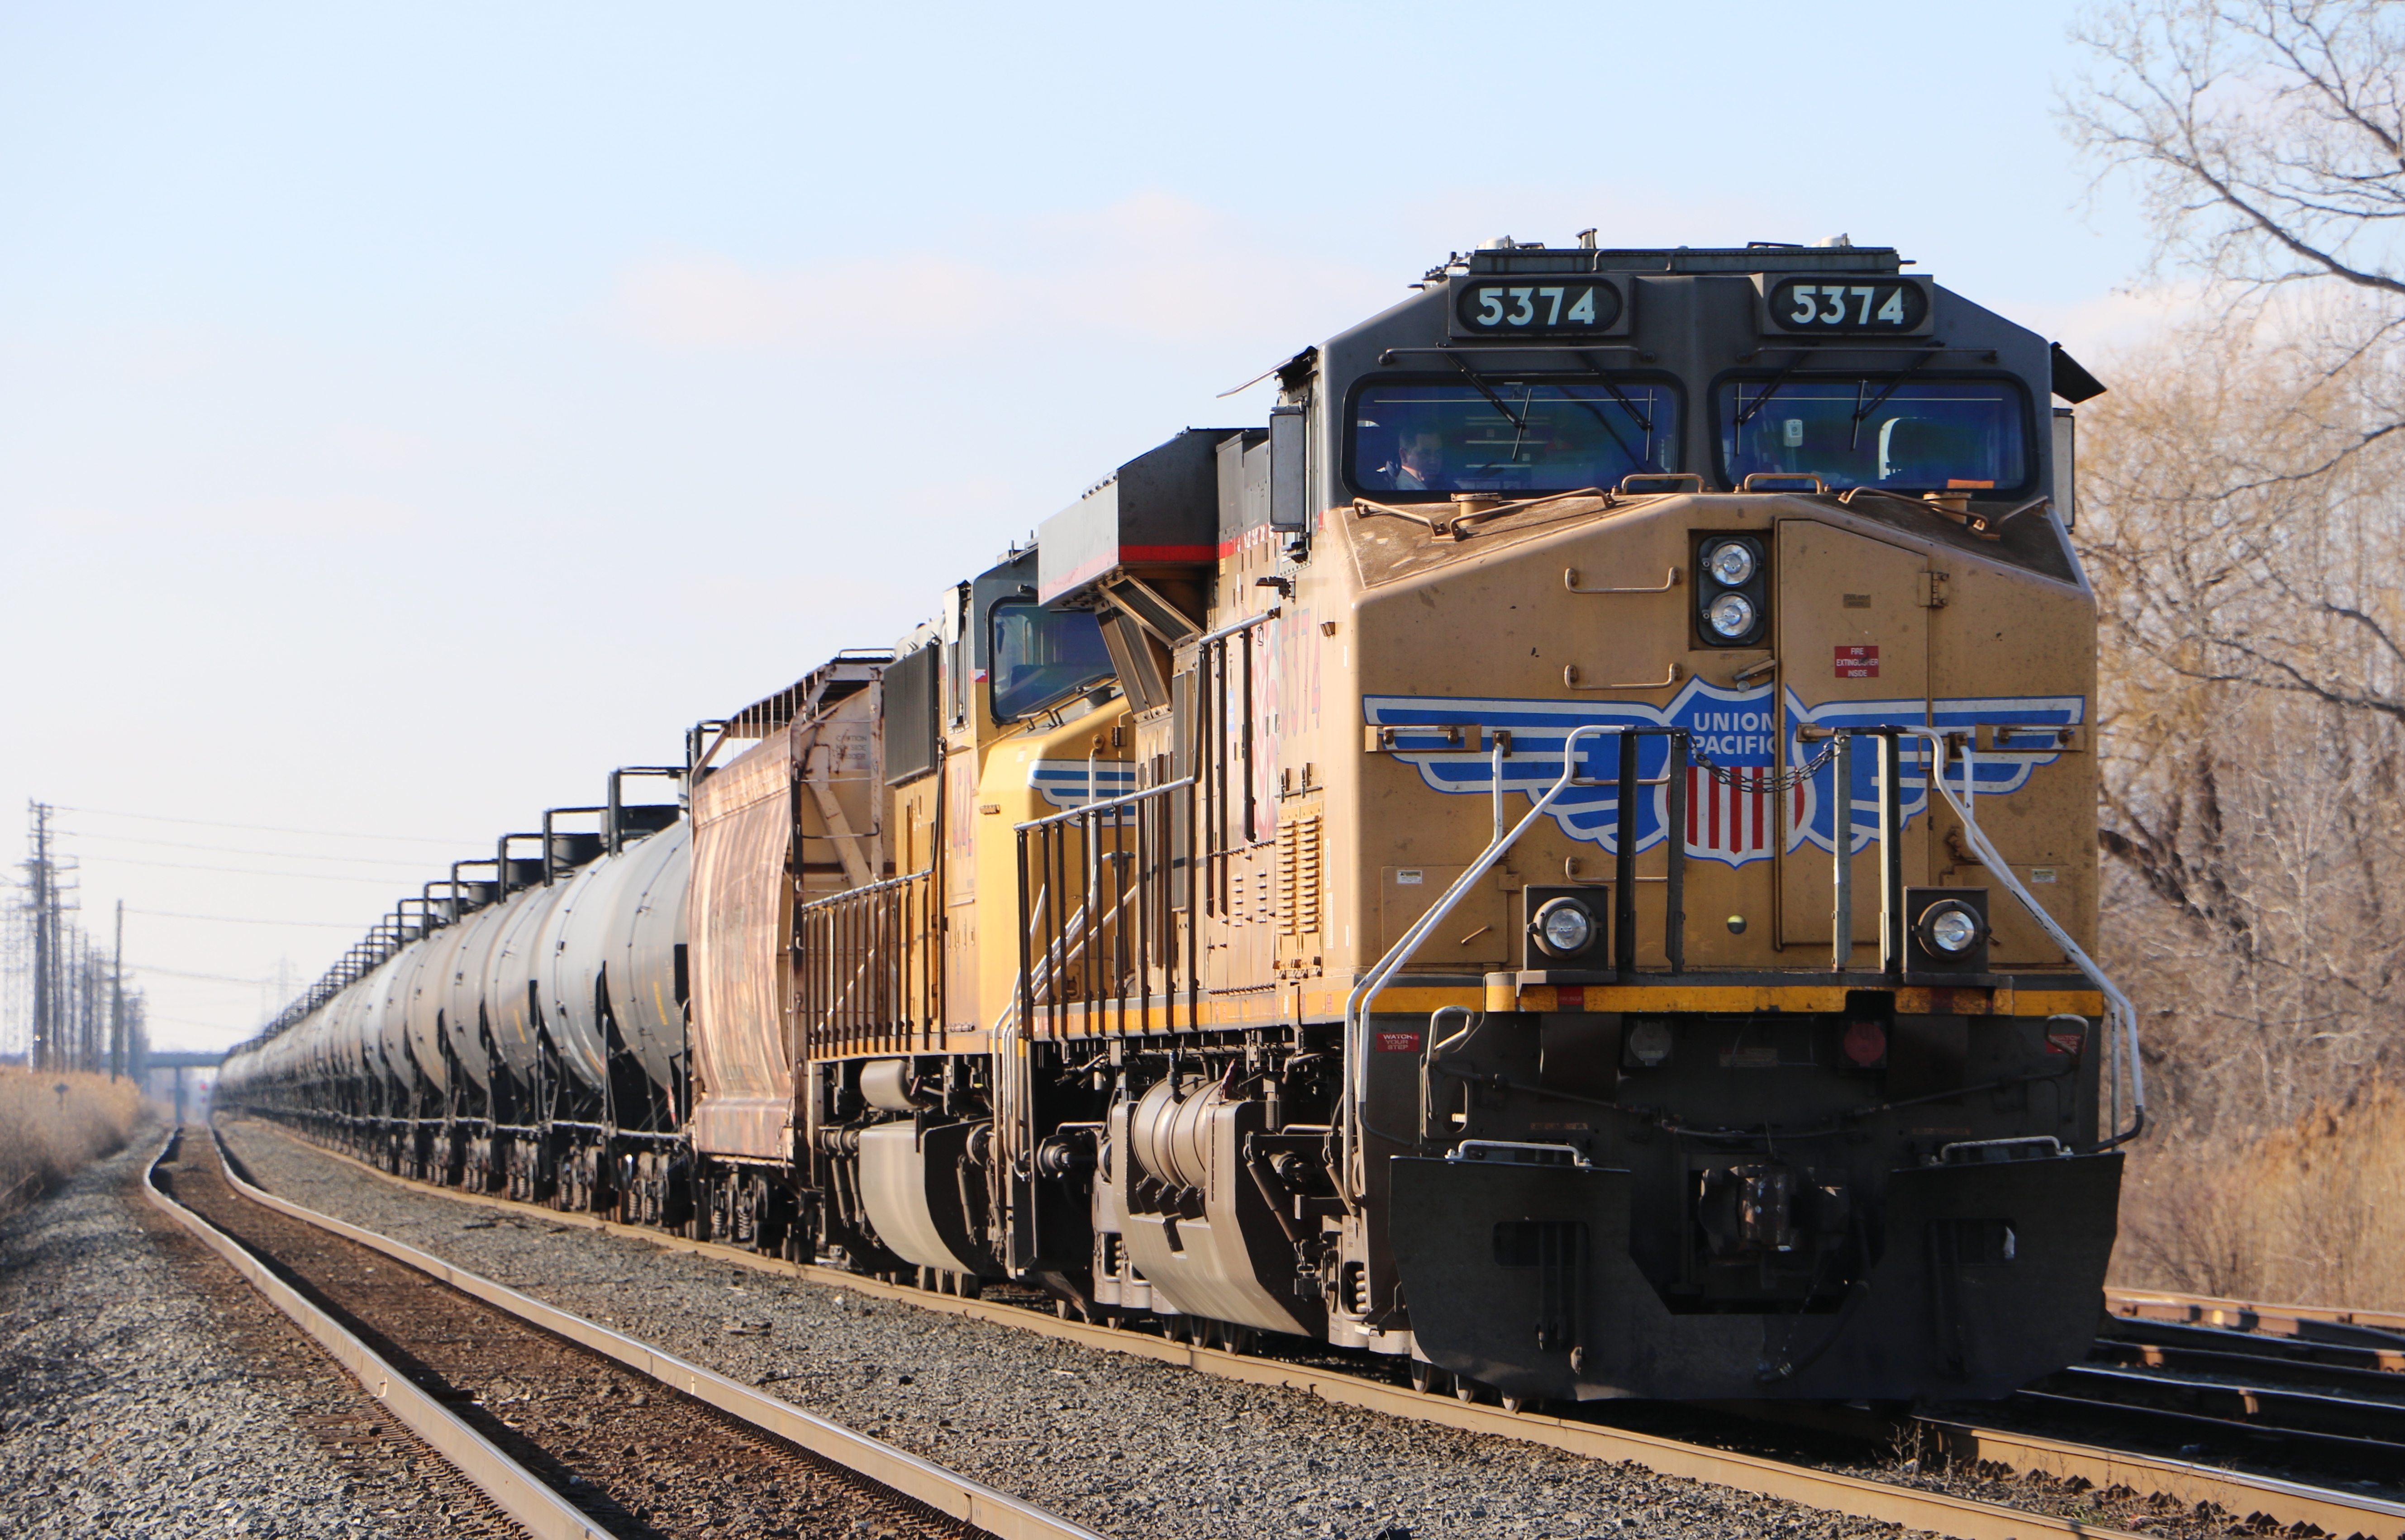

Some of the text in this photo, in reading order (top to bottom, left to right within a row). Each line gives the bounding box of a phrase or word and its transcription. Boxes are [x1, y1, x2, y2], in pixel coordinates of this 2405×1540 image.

[1476, 286, 1595, 326] 5374
[1791, 285, 1904, 324] 5374
[1281, 601, 1320, 741] 5374
[1694, 712, 1775, 732] UNION
